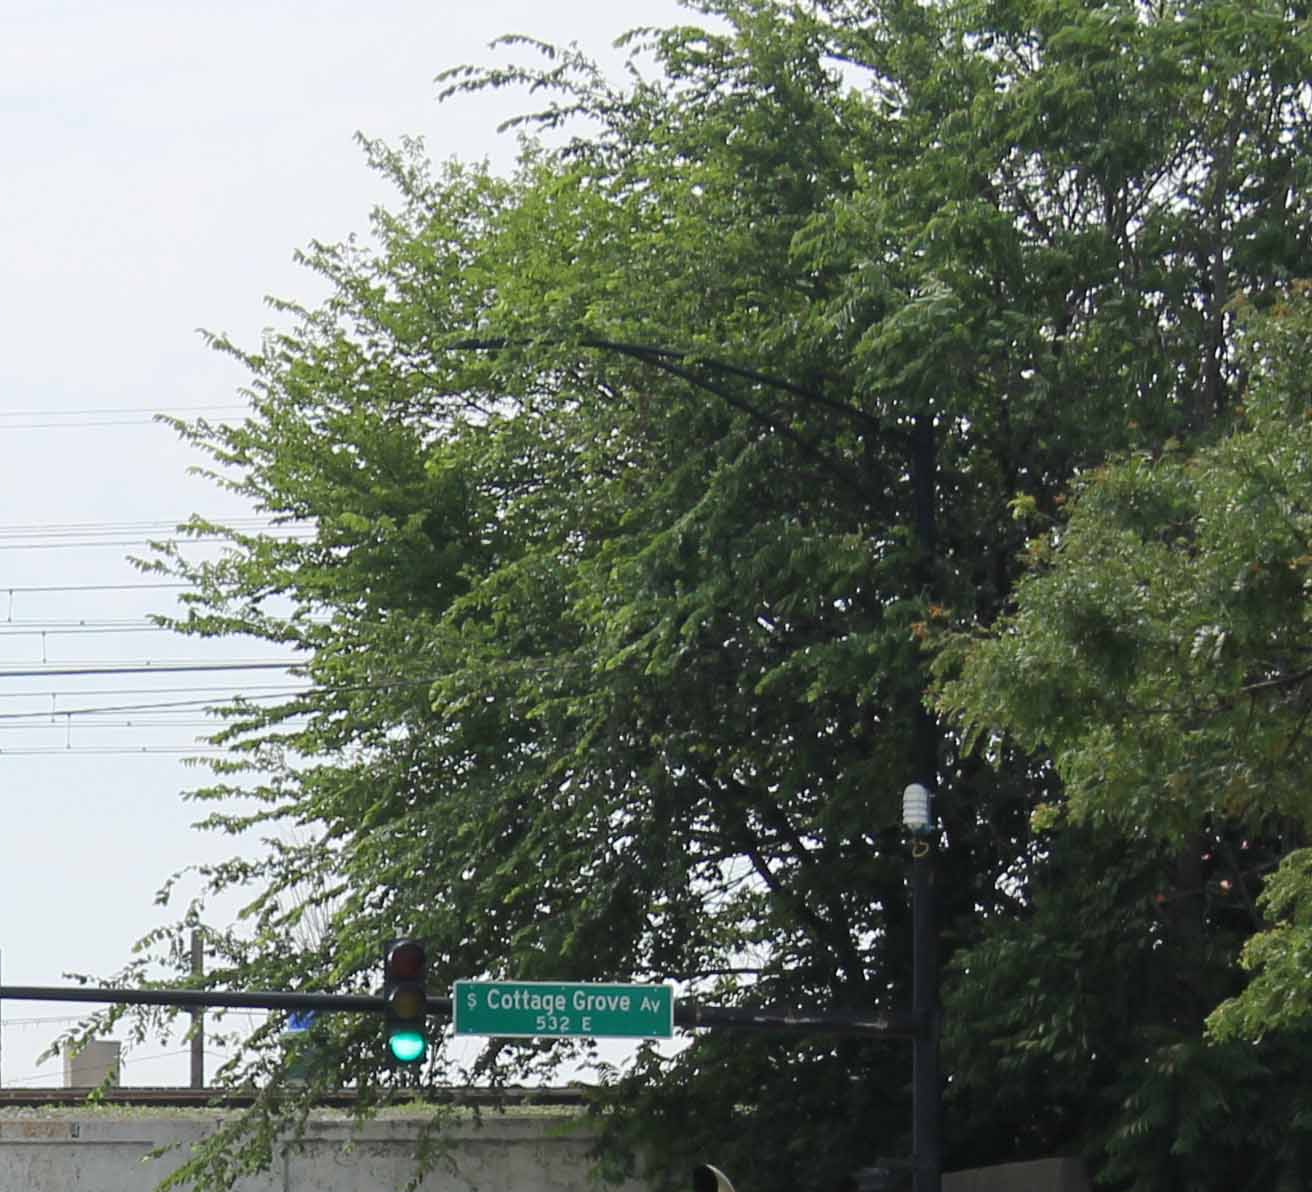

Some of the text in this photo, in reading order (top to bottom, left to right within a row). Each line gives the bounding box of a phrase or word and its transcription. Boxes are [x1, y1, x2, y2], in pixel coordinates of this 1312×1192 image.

[467, 988, 660, 1015] S Cottage Grove Av
[536, 1016, 592, 1031] 532 E
